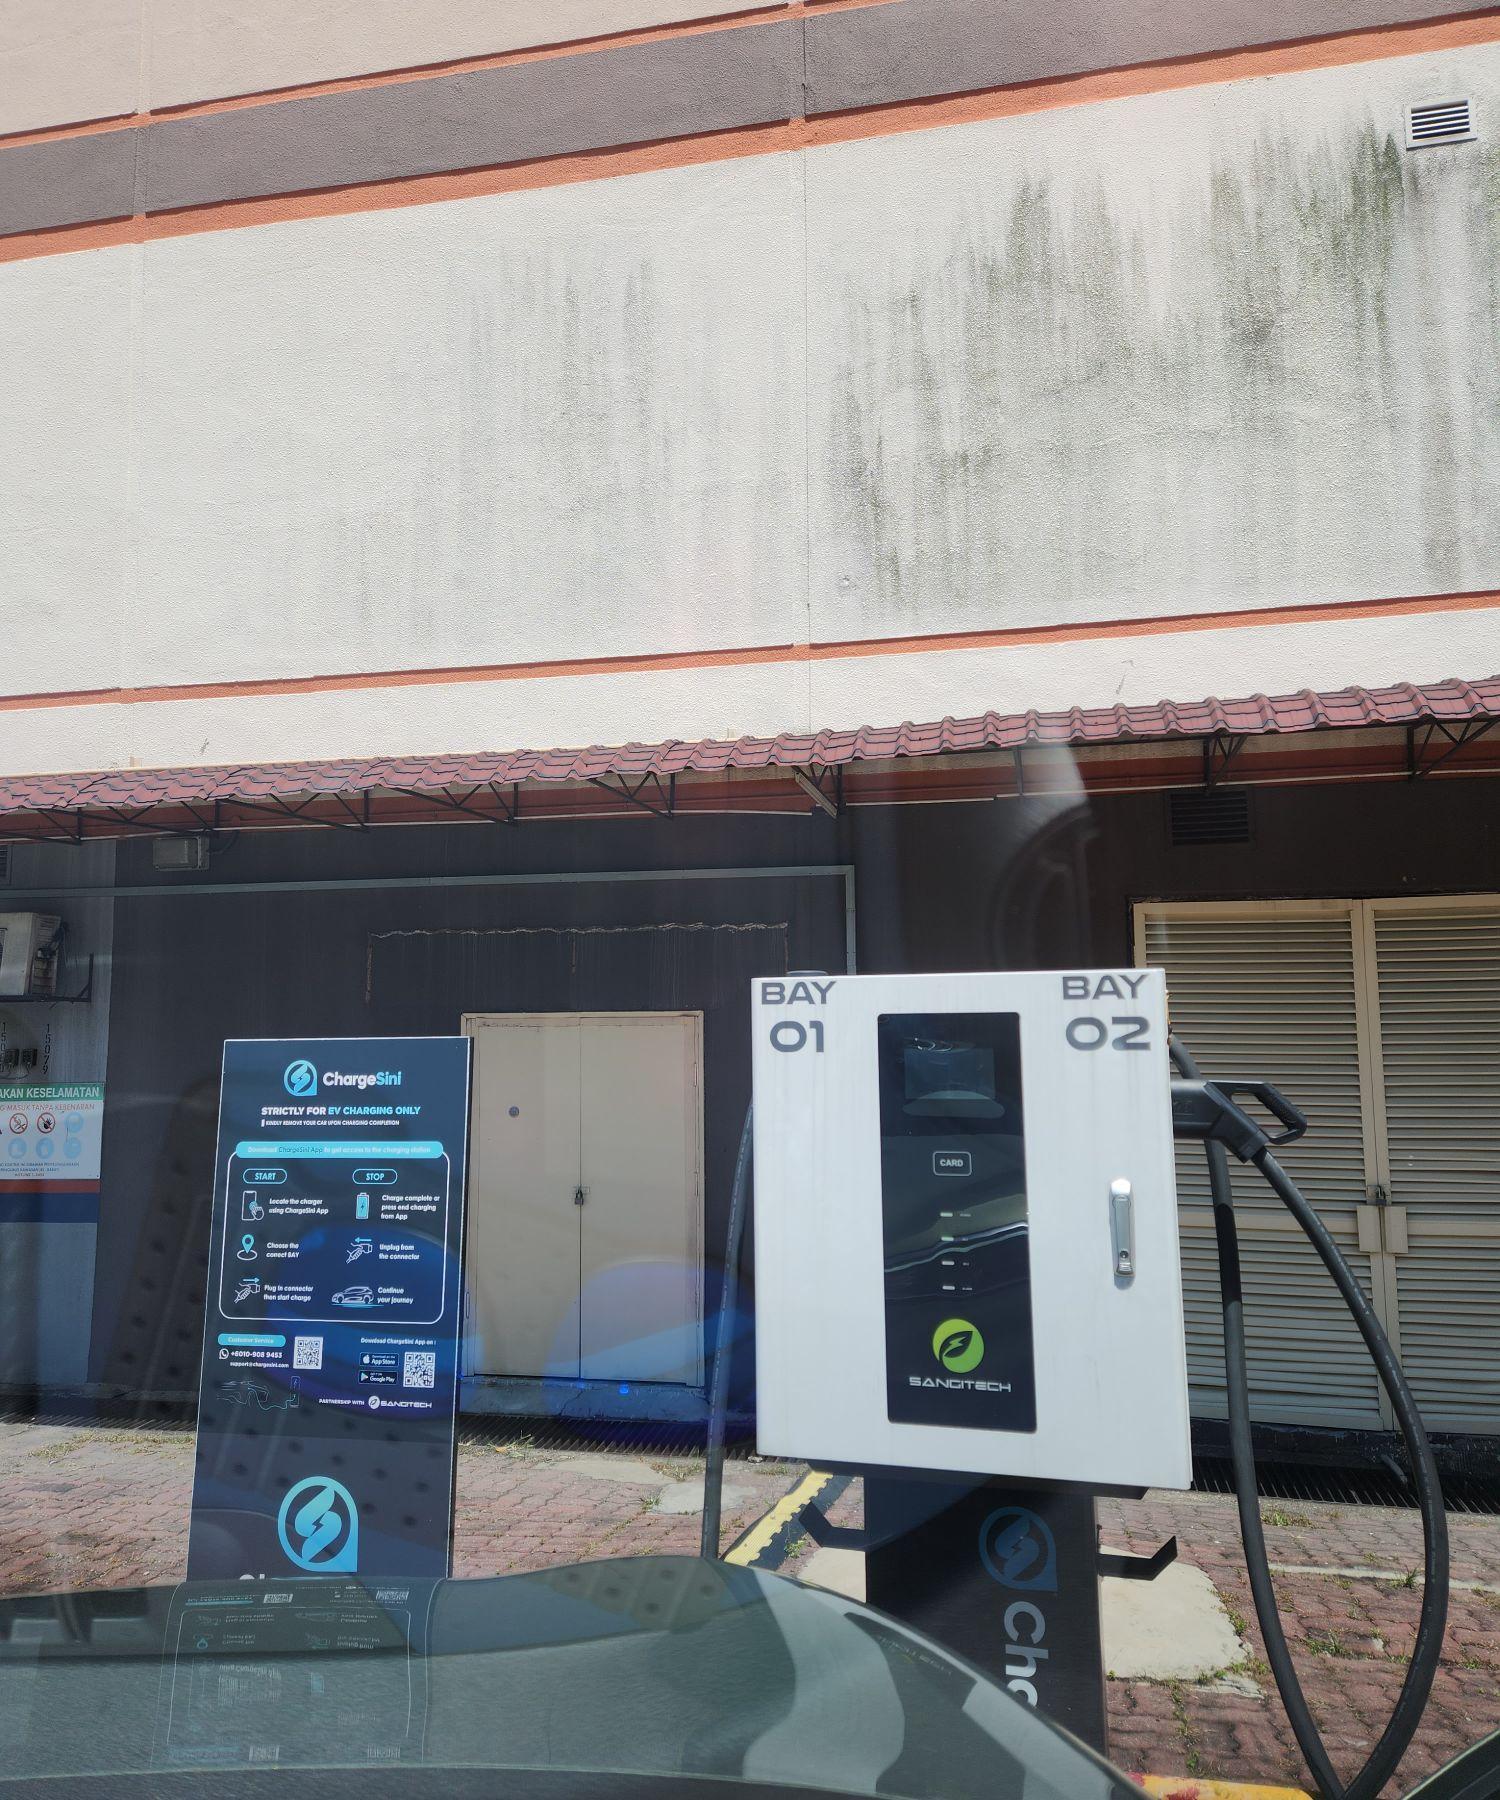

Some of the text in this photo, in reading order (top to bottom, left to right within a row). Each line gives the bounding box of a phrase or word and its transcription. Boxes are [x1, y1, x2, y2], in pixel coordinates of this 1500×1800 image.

[762, 981, 836, 1005] BAY
[1062, 974, 1150, 1000] BAY
[770, 1020, 824, 1053] 01
[1066, 1016, 1151, 1051] 02
[322, 1071, 402, 1090] ChargeSini
[27, 1087, 99, 1098] KESELAMATAN
[261, 1106, 420, 1115] STRICTLY FOR EV CHARGING ONLY
[940, 1159, 963, 1167] CARD
[909, 1376, 1012, 1393] SANGITECH
